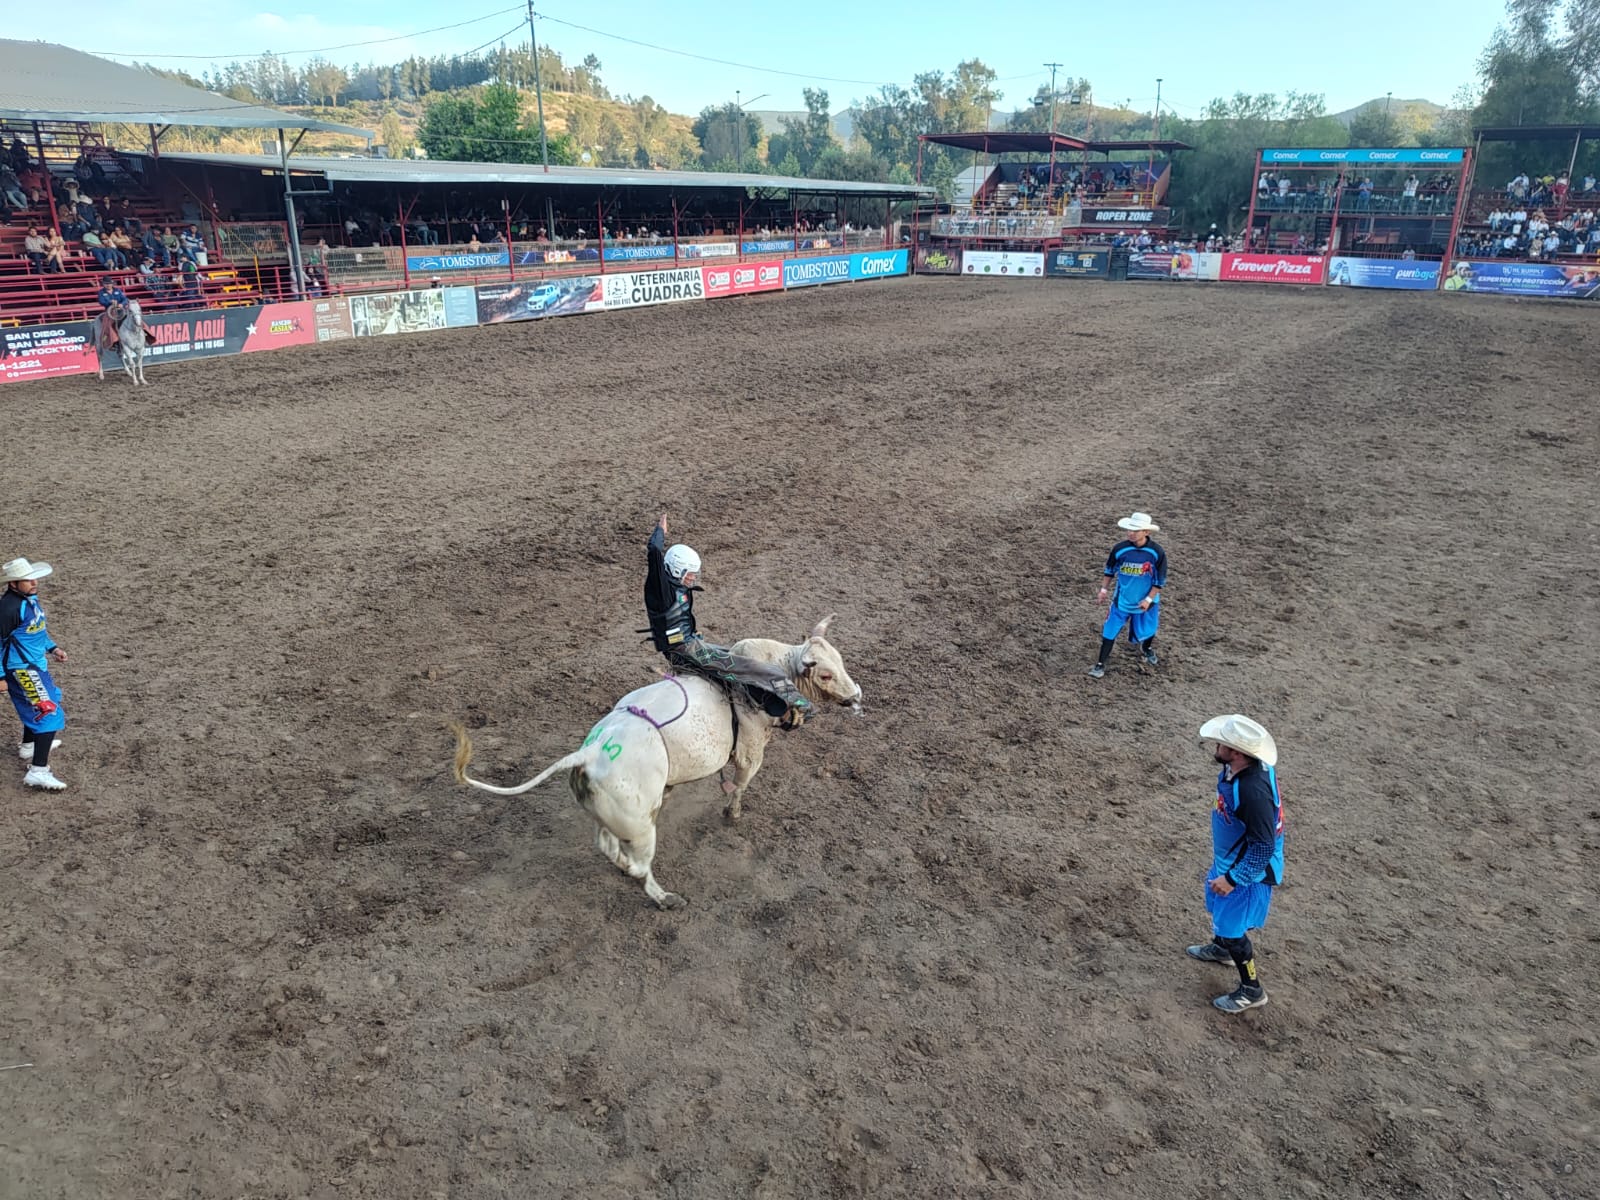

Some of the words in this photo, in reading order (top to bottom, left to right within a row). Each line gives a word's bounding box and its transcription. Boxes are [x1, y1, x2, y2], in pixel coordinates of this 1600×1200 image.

[1096, 211, 1127, 221] ROPER
[1128, 212, 1153, 221] ZONE
[624, 247, 667, 258] TOMBSTONE
[440, 254, 500, 267] TOMBSTONE
[861, 253, 897, 275] Comex
[1231, 258, 1276, 273] Forever
[1275, 260, 1312, 276] Pizza
[785, 261, 849, 280] TOMBSTONE
[631, 270, 701, 286] VETERINARIA
[1478, 276, 1512, 284] EXPERTOS
[1522, 277, 1566, 286] PROTECCIÓN
[631, 282, 703, 303] CUADRAS
[194, 315, 225, 340] AQUÍ
[5, 333, 30, 341] SAN
[32, 329, 66, 338] DIEGO
[7, 341, 32, 349] SAN
[34, 336, 86, 347] LEANDRO
[21, 344, 83, 356] STOCKTON
